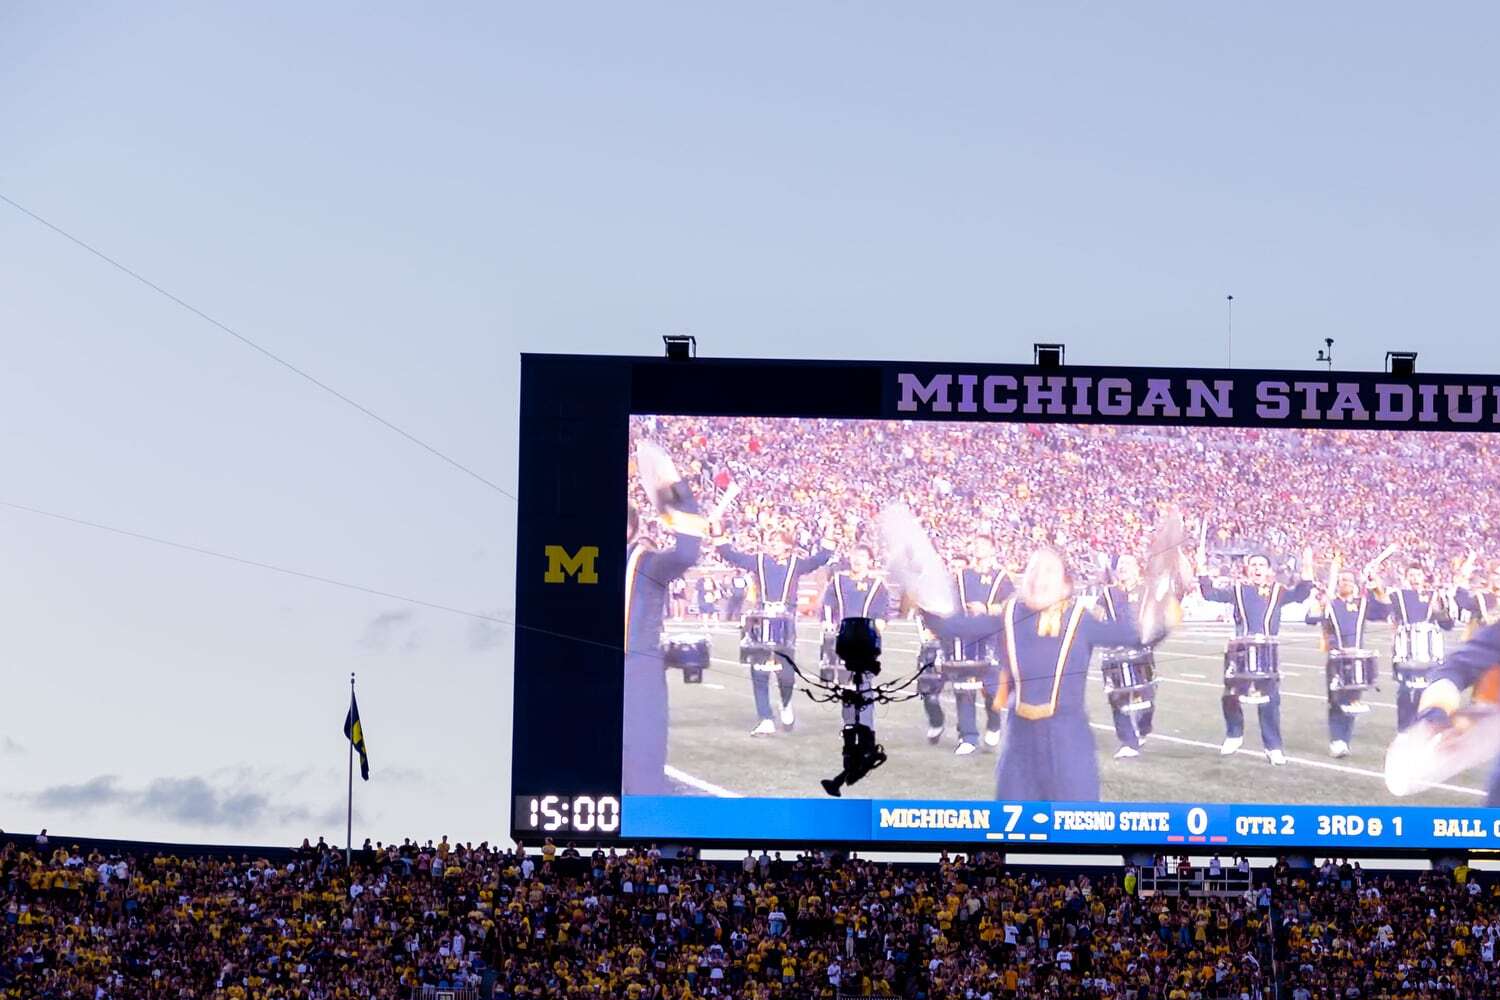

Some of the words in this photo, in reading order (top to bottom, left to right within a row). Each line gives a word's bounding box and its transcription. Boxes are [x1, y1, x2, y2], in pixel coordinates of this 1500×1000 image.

[897, 372, 1235, 418] MICHIGAN
[545, 546, 598, 583] M
[530, 795, 619, 832] 15:00
[880, 808, 990, 829] MICHIGAN
[1003, 805, 1023, 832] 7
[1054, 810, 1115, 831] FRESNO
[1119, 811, 1170, 832] STATE
[1187, 807, 1207, 835] 0
[1235, 815, 1277, 836] QTR
[1281, 815, 1295, 835] 2
[1317, 815, 1364, 836] 3RD
[1392, 816, 1403, 836] 1
[1433, 818, 1487, 838] BALL
